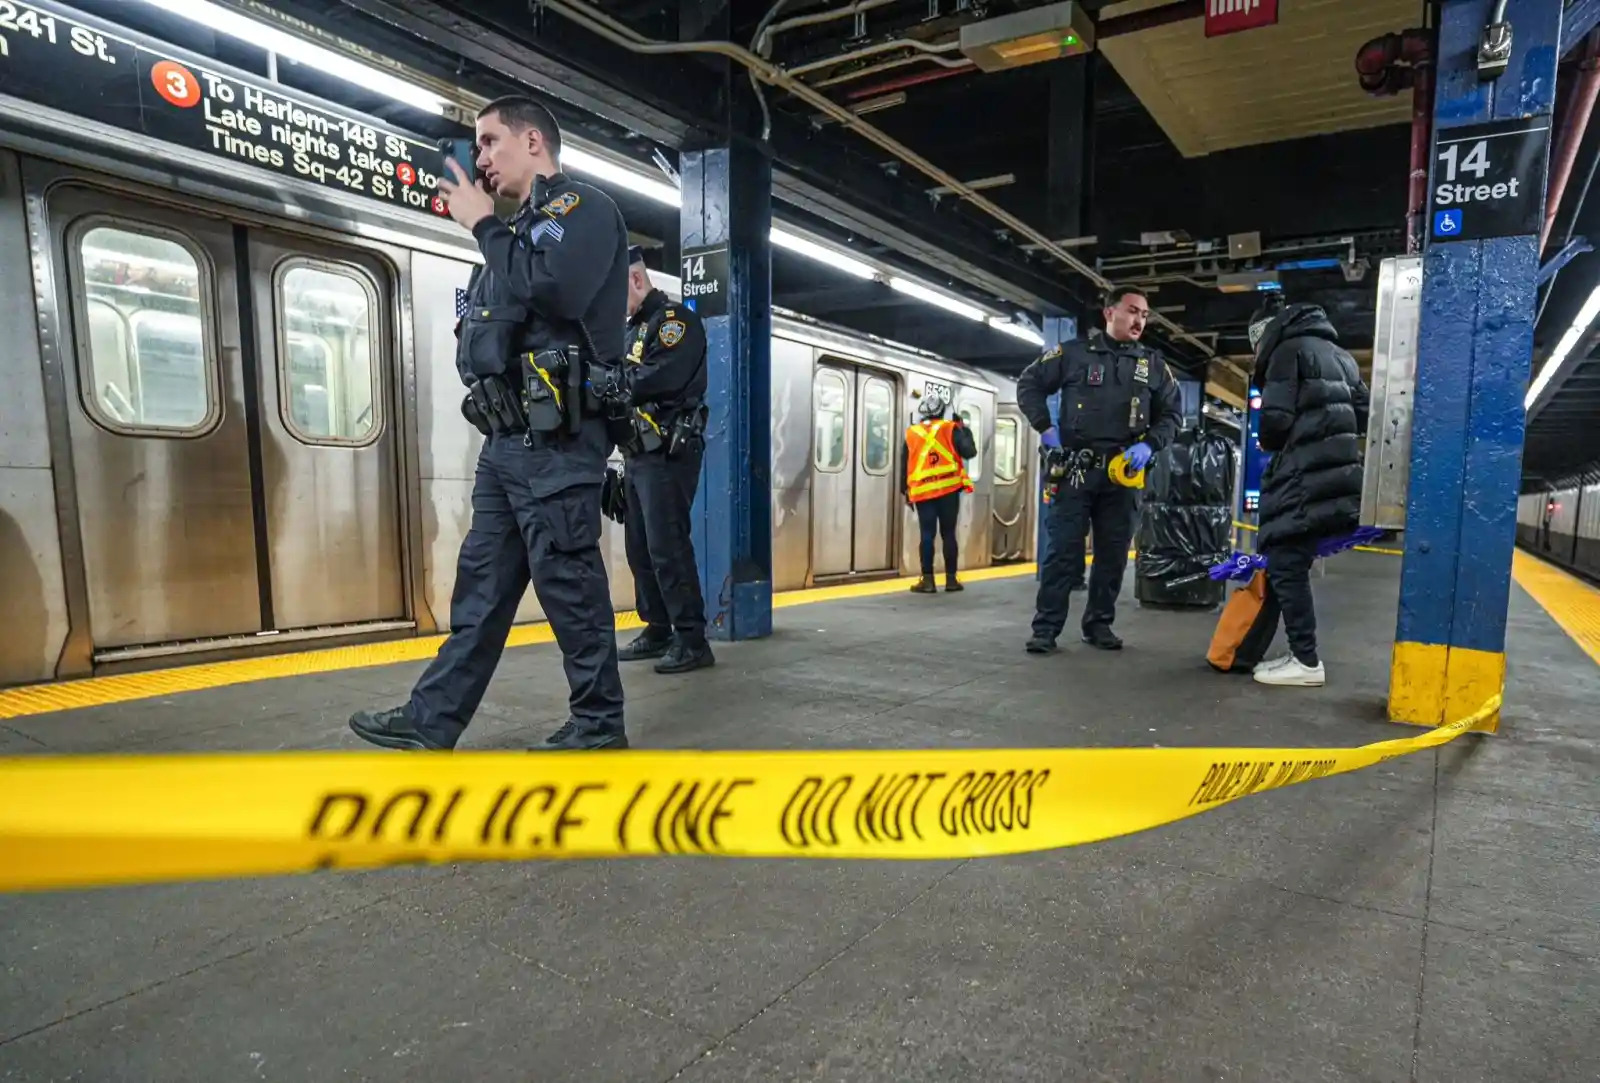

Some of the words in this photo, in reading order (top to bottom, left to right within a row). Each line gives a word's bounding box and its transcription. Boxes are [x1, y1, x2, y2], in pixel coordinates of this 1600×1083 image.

[70, 26, 117, 65] St.
[166, 71, 189, 99] 3
[201, 71, 235, 103] To
[243, 86, 378, 150] Harlem-148
[384, 135, 413, 162] St.
[203, 97, 262, 136] Late
[271, 123, 341, 160] nights
[347, 144, 395, 177] take
[401, 166, 412, 181] 2
[205, 124, 285, 167] Times
[292, 151, 365, 190] Sq-42
[371, 174, 395, 199] St
[401, 184, 429, 208] for
[434, 198, 445, 213] 3
[1438, 140, 1491, 182] 14
[1435, 177, 1520, 205] Street
[683, 256, 706, 282] 14
[683, 279, 719, 297] Street
[776, 774, 854, 849] DO
[853, 772, 948, 843] NOT
[938, 767, 1052, 837] CROSS
